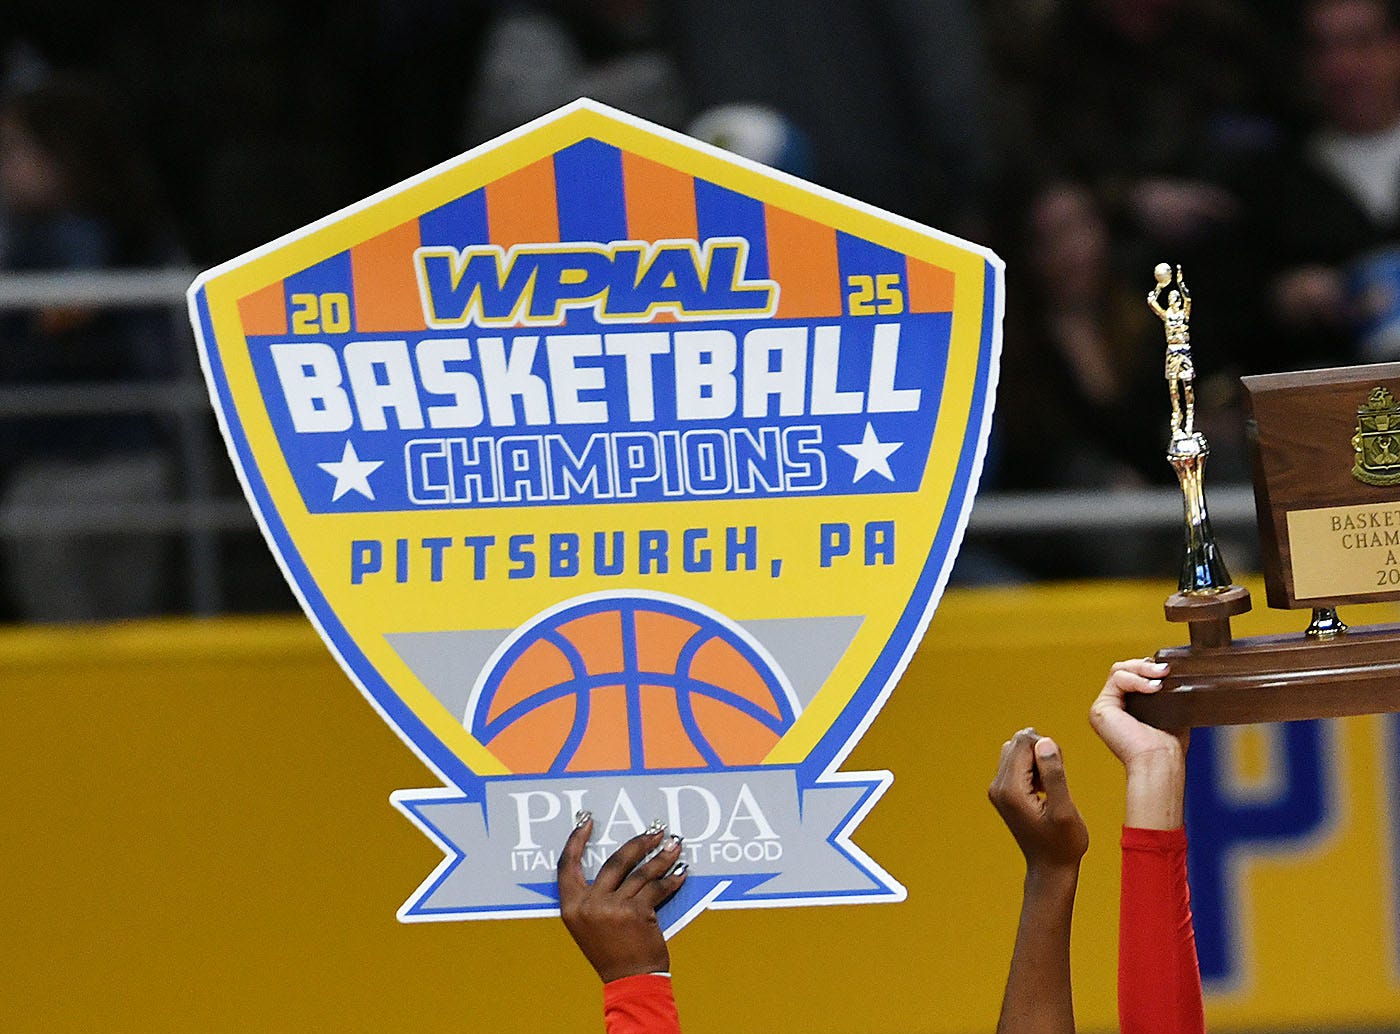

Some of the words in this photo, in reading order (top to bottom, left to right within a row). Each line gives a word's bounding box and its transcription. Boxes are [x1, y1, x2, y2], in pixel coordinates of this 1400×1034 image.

[291, 293, 351, 336] 20
[416, 241, 778, 328] WPIAL
[847, 275, 904, 316] 25
[270, 324, 922, 434] BASKETBALL
[402, 426, 827, 506] CHAMPIONS
[351, 524, 784, 586] PITTSBURGH,
[819, 520, 896, 567] PA
[710, 841, 783, 863] FOOD
